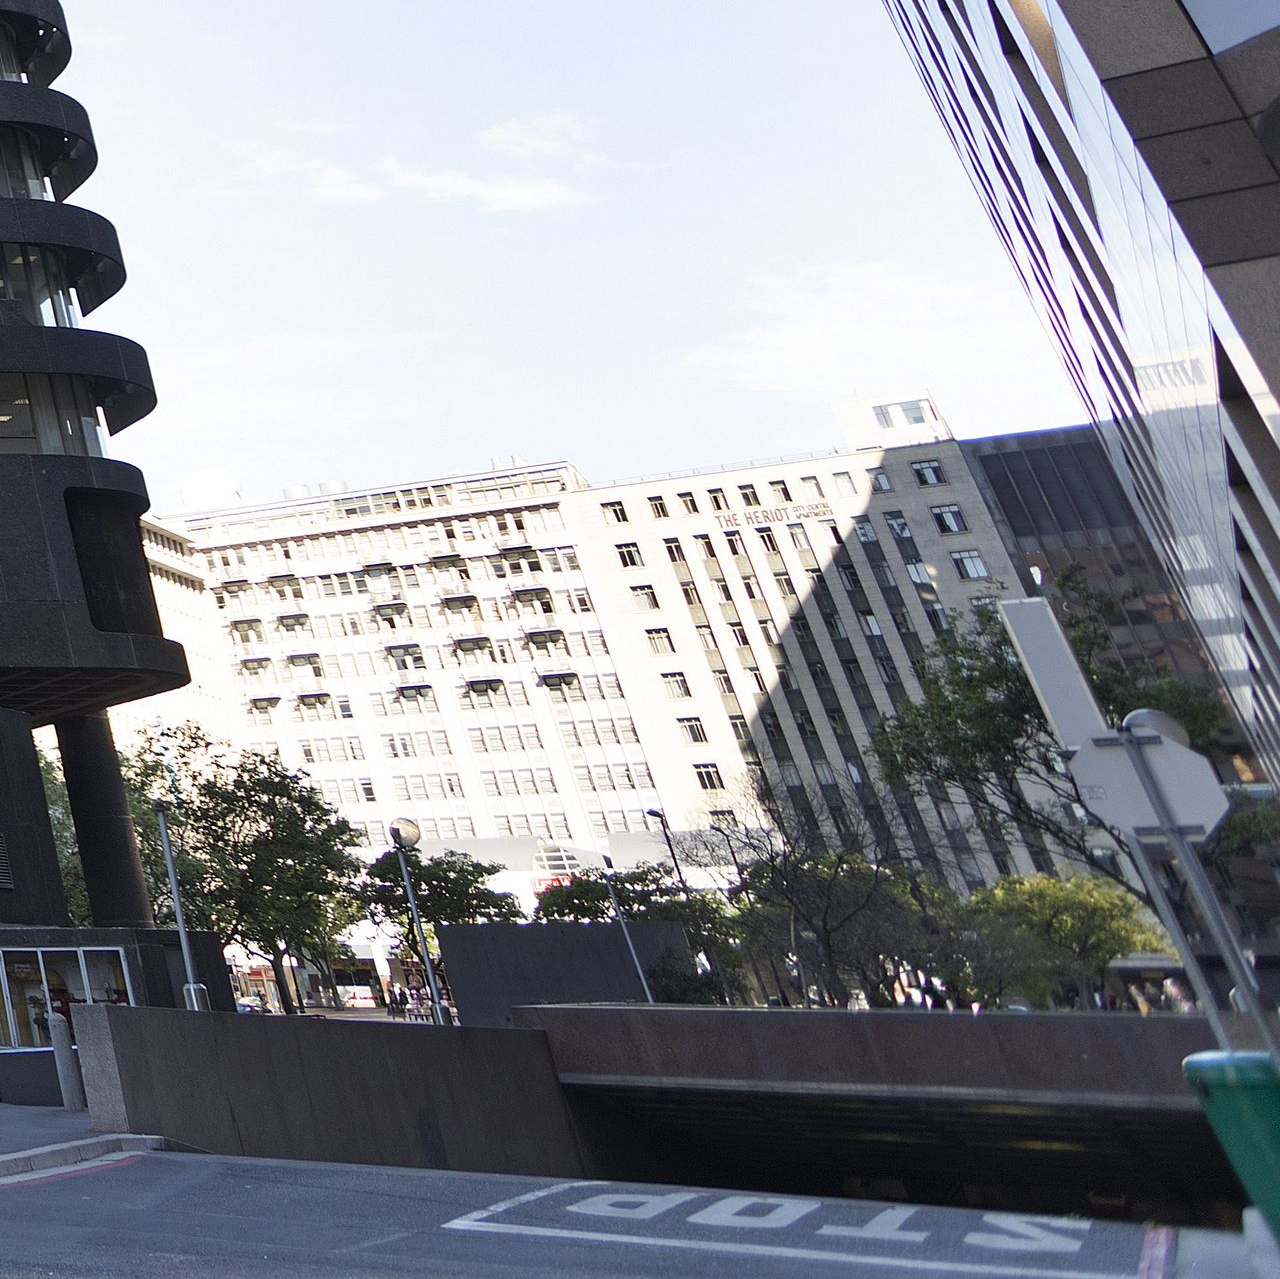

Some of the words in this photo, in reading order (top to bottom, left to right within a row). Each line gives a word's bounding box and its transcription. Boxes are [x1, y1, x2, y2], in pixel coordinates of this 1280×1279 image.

[715, 513, 741, 528] THE
[744, 507, 790, 525] HERIOT
[566, 1192, 1092, 1253] STOP
